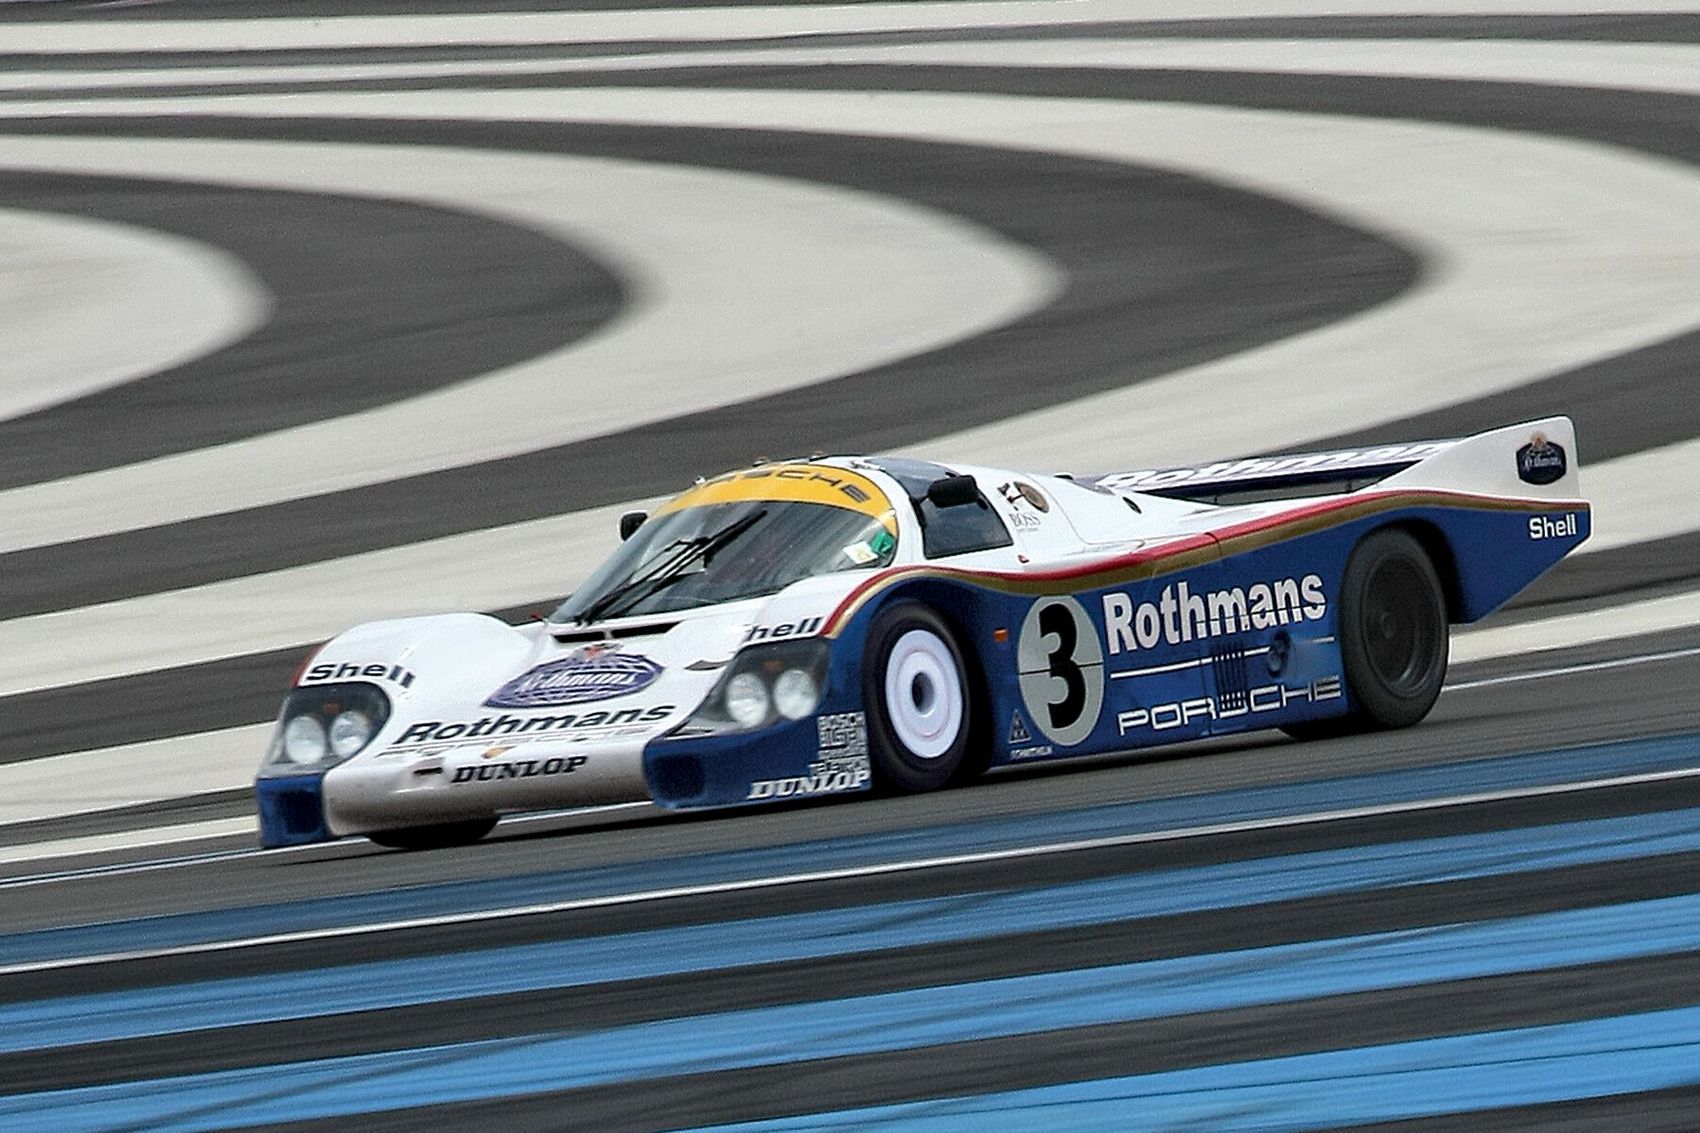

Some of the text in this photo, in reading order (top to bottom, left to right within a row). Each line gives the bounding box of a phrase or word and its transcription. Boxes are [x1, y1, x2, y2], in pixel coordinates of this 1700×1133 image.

[1529, 513, 1578, 539] Shell
[1102, 573, 1327, 654] Rothmans
[306, 662, 415, 689] Shell
[1038, 602, 1087, 729] 3
[1117, 676, 1342, 736] PORSCHE
[393, 705, 677, 746] Rothmans
[451, 755, 588, 784] DUNLOP
[747, 770, 870, 800] DUNLOP
